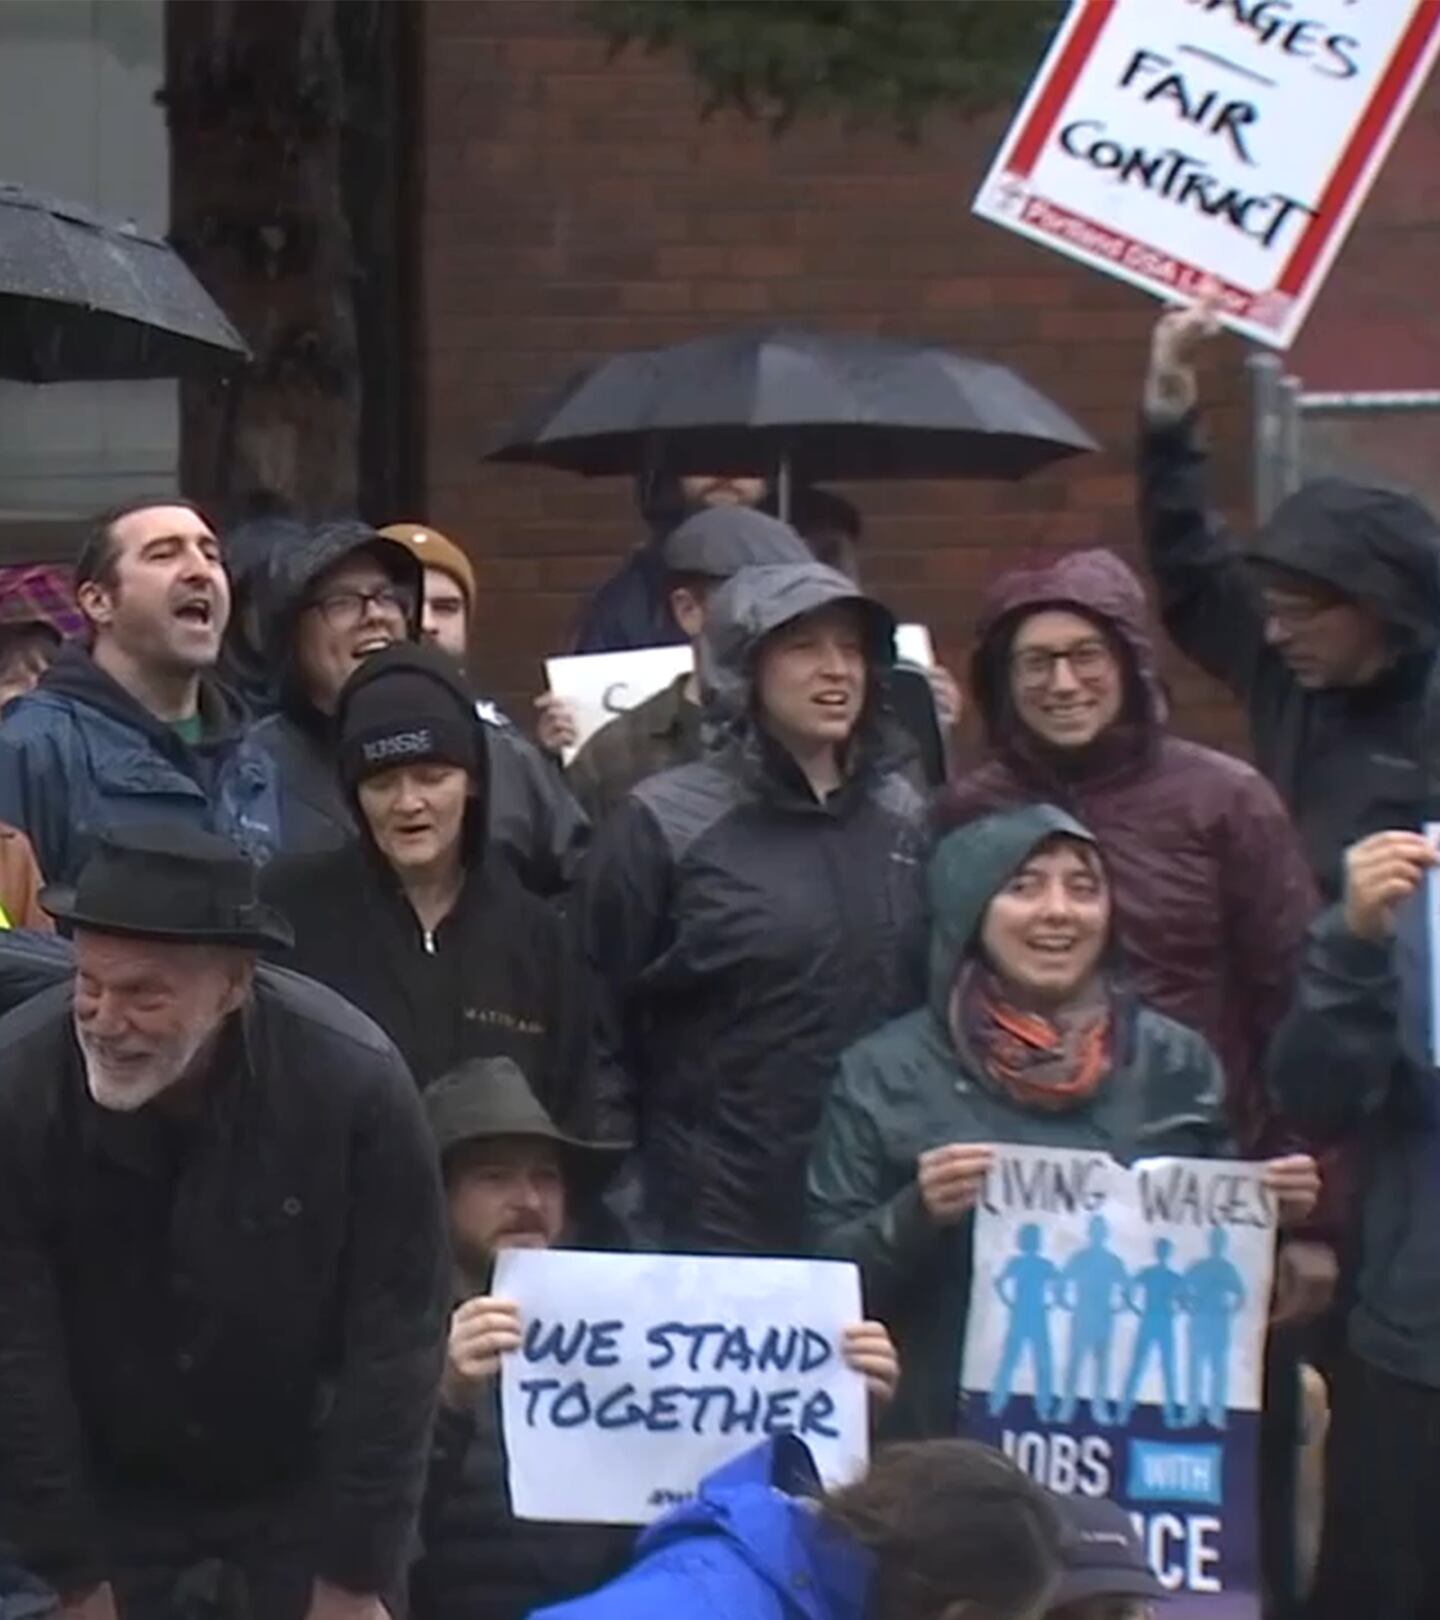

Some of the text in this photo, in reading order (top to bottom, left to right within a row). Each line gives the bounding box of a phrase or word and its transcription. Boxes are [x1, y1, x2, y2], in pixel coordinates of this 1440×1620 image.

[1117, 48, 1259, 168] FAIR
[1058, 118, 1320, 249] CONTRACT
[521, 1318, 834, 1372] WE STAND
[519, 1378, 840, 1438] TOGETHER
[1143, 1454, 1212, 1492] WITH
